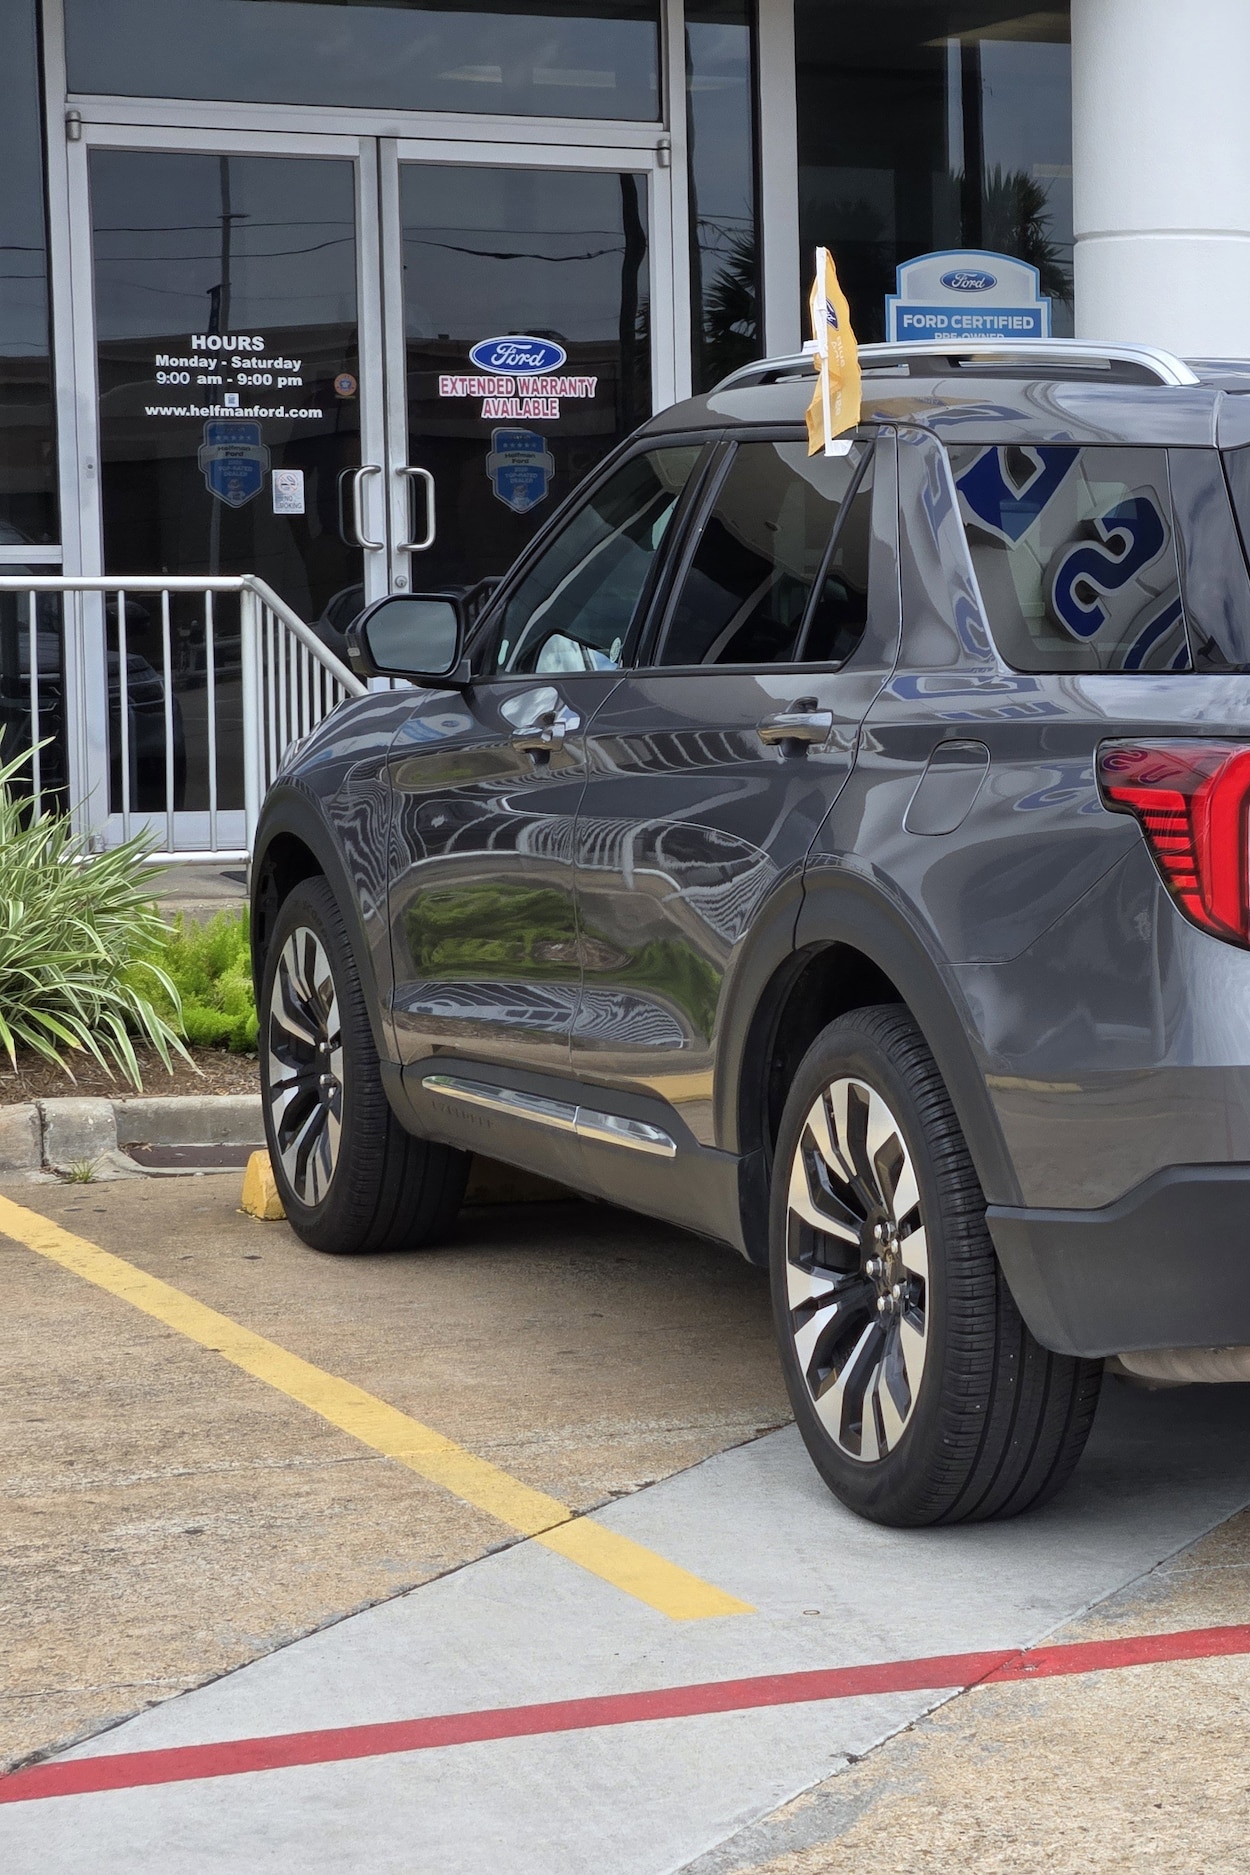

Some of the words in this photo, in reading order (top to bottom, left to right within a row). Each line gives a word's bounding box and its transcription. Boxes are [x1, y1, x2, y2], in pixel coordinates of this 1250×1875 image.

[951, 273, 986, 289] Ford
[903, 314, 949, 328] FORD
[951, 315, 1034, 330] CERTIFIED
[191, 335, 265, 351] HOURS
[491, 343, 546, 367] Ford
[155, 355, 218, 370] Monday
[231, 356, 302, 372] Saturday
[156, 372, 190, 385] 9:00
[196, 374, 222, 385] am
[237, 373, 273, 386] 9:00
[277, 375, 303, 388] pm
[440, 376, 515, 396] EXTENDED
[518, 376, 597, 397] WARRANTY
[145, 405, 323, 419] www.helfmanford.com
[482, 399, 559, 418] AVAILABLE
